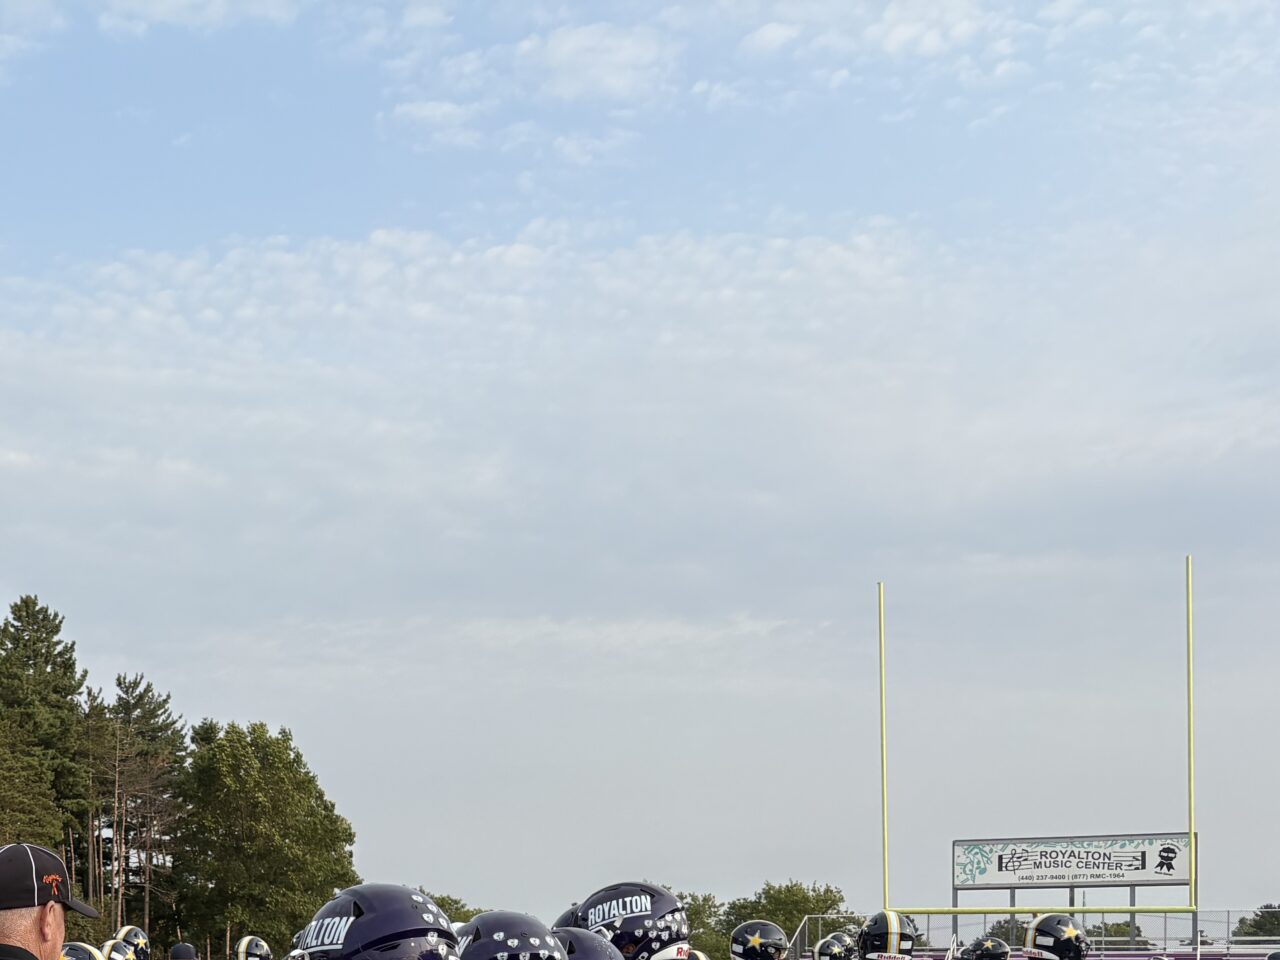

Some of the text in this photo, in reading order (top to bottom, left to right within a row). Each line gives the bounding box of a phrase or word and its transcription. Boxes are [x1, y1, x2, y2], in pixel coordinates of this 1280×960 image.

[1039, 849, 1112, 861] ROYALTON
[1033, 859, 1124, 871] MUSIC CENTER
[1089, 872, 1125, 880] RMC-1964
[588, 894, 652, 927] ROYALTON
[877, 953, 906, 960] Riddell
